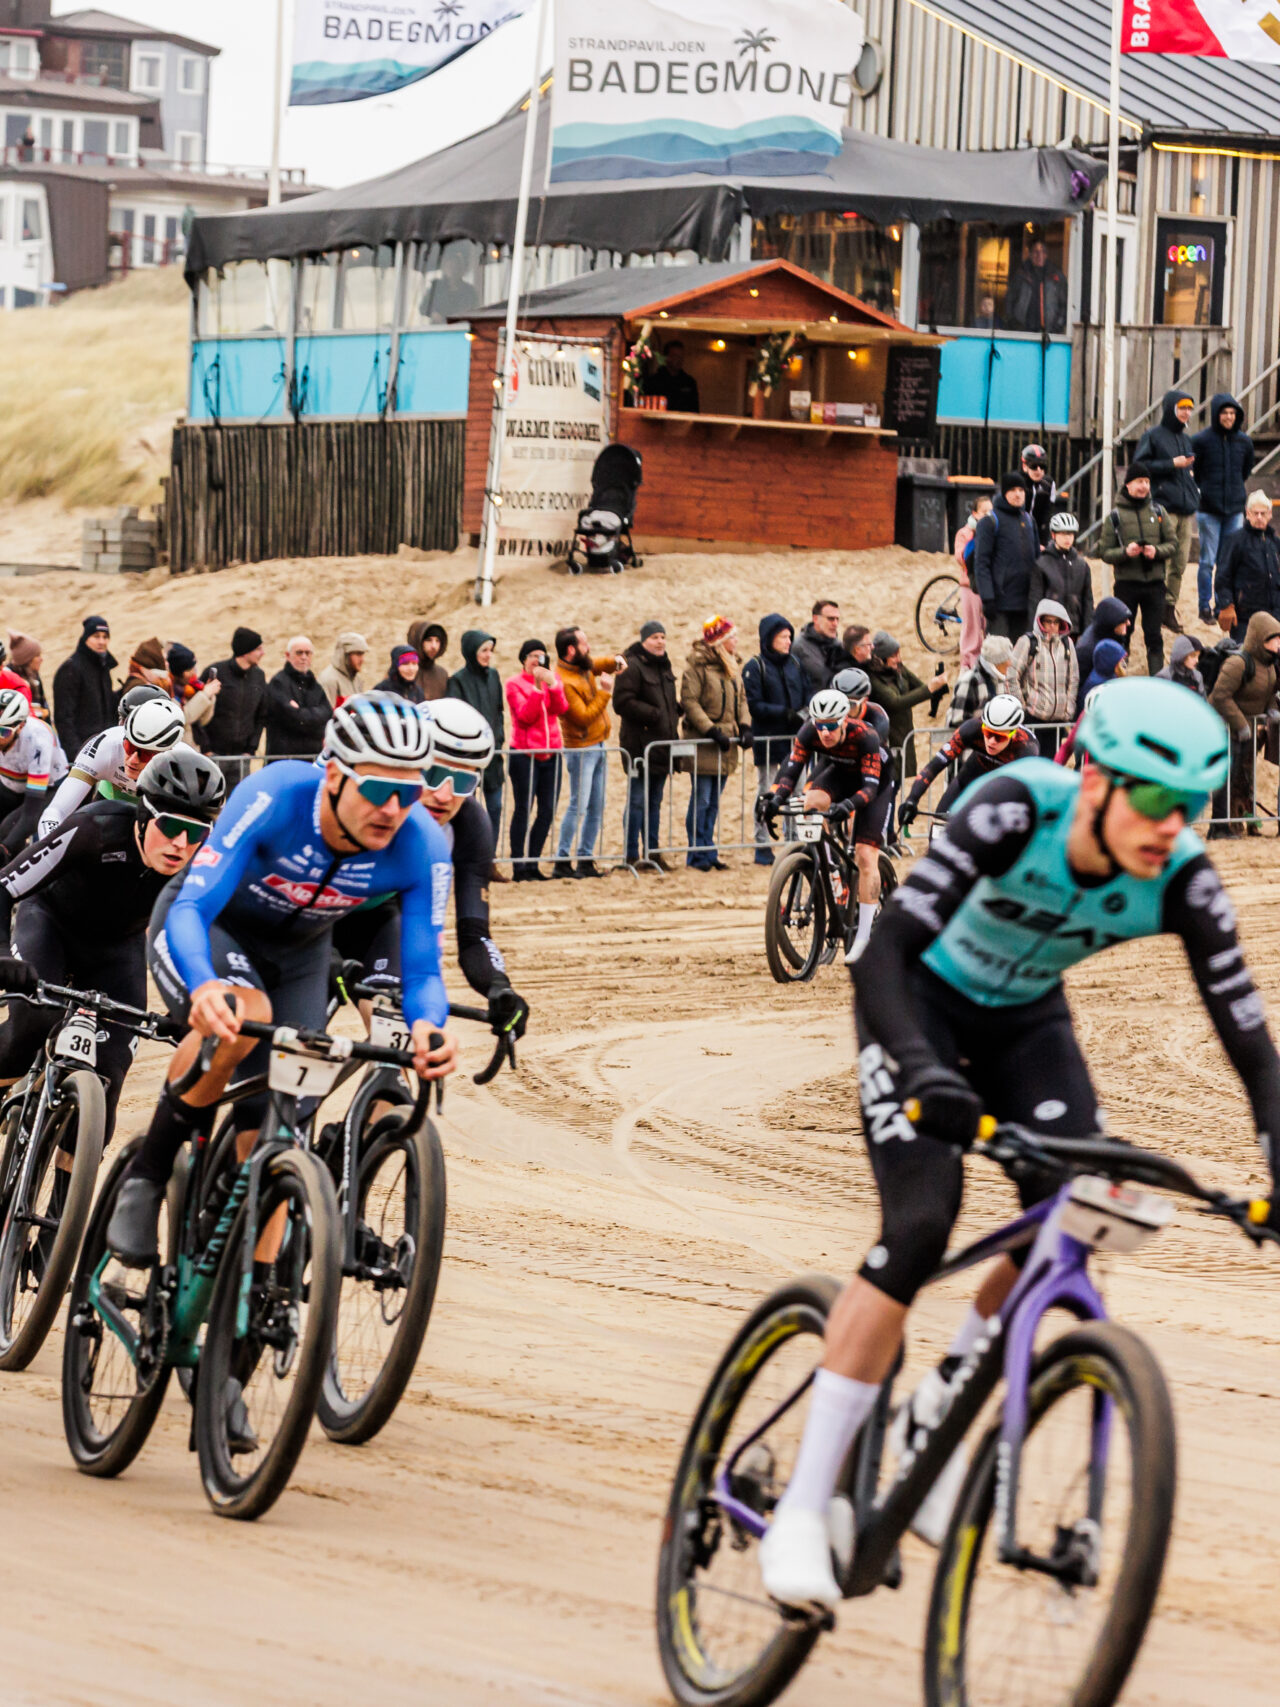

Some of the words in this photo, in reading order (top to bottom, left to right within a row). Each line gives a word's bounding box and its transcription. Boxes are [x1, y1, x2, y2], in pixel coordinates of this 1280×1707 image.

[323, 15, 492, 43] BADEGMON
[569, 37, 706, 52] STRANDPAVILJOEN
[569, 58, 851, 107] BADEGMOND
[1168, 245, 1206, 265] open
[500, 490, 544, 510] ROODJE
[548, 491, 589, 510] ROOKWO
[70, 1035, 92, 1056] 38
[390, 1032, 411, 1051] 37
[296, 1066, 308, 1087] 7
